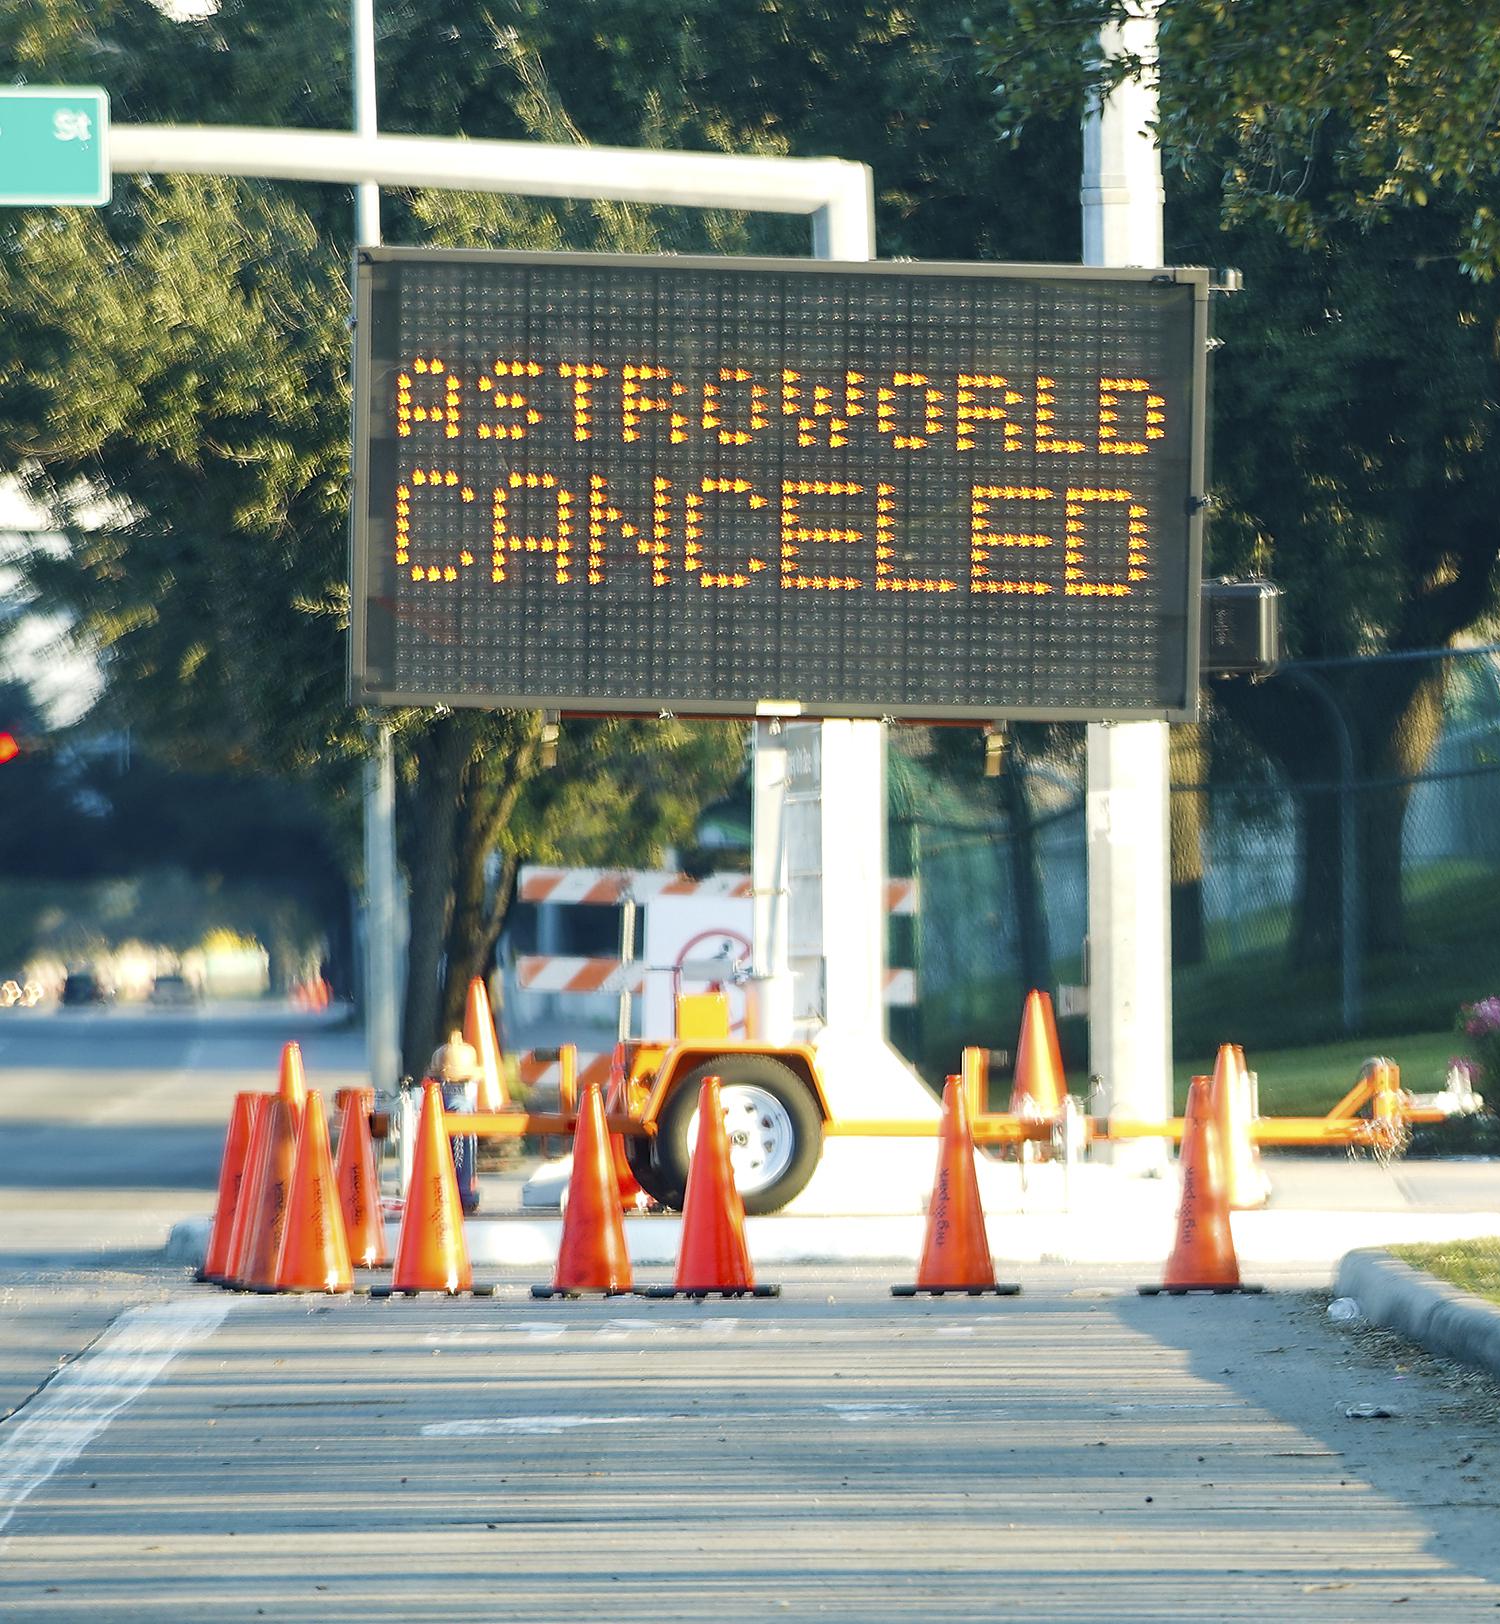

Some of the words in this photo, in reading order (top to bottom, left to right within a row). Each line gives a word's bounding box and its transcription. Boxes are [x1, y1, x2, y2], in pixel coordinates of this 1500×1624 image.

[53, 107, 93, 142] St
[396, 357, 1168, 456] ASTROWORLD
[395, 468, 1149, 598] CANCELED
[938, 1167, 951, 1201] park
